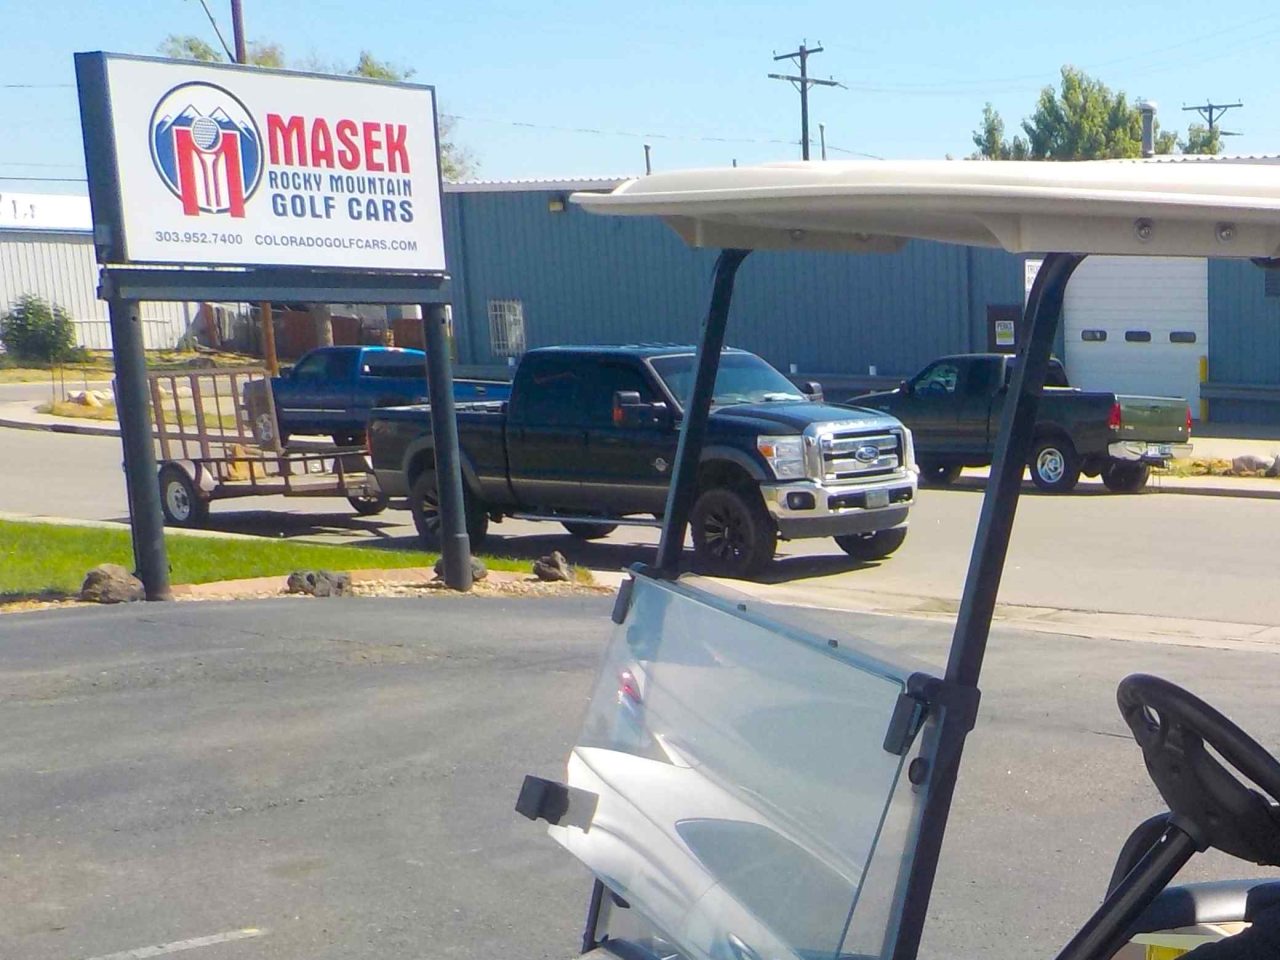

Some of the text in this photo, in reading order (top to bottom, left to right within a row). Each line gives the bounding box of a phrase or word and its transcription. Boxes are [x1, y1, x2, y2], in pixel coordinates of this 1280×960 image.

[266, 113, 411, 174] MASEK
[268, 171, 412, 197] ROCKY MOUNTAIN
[272, 193, 414, 223] GOLF CARS
[155, 231, 418, 251] 303.952.7400 COLORADOGOLFCARS.COM
